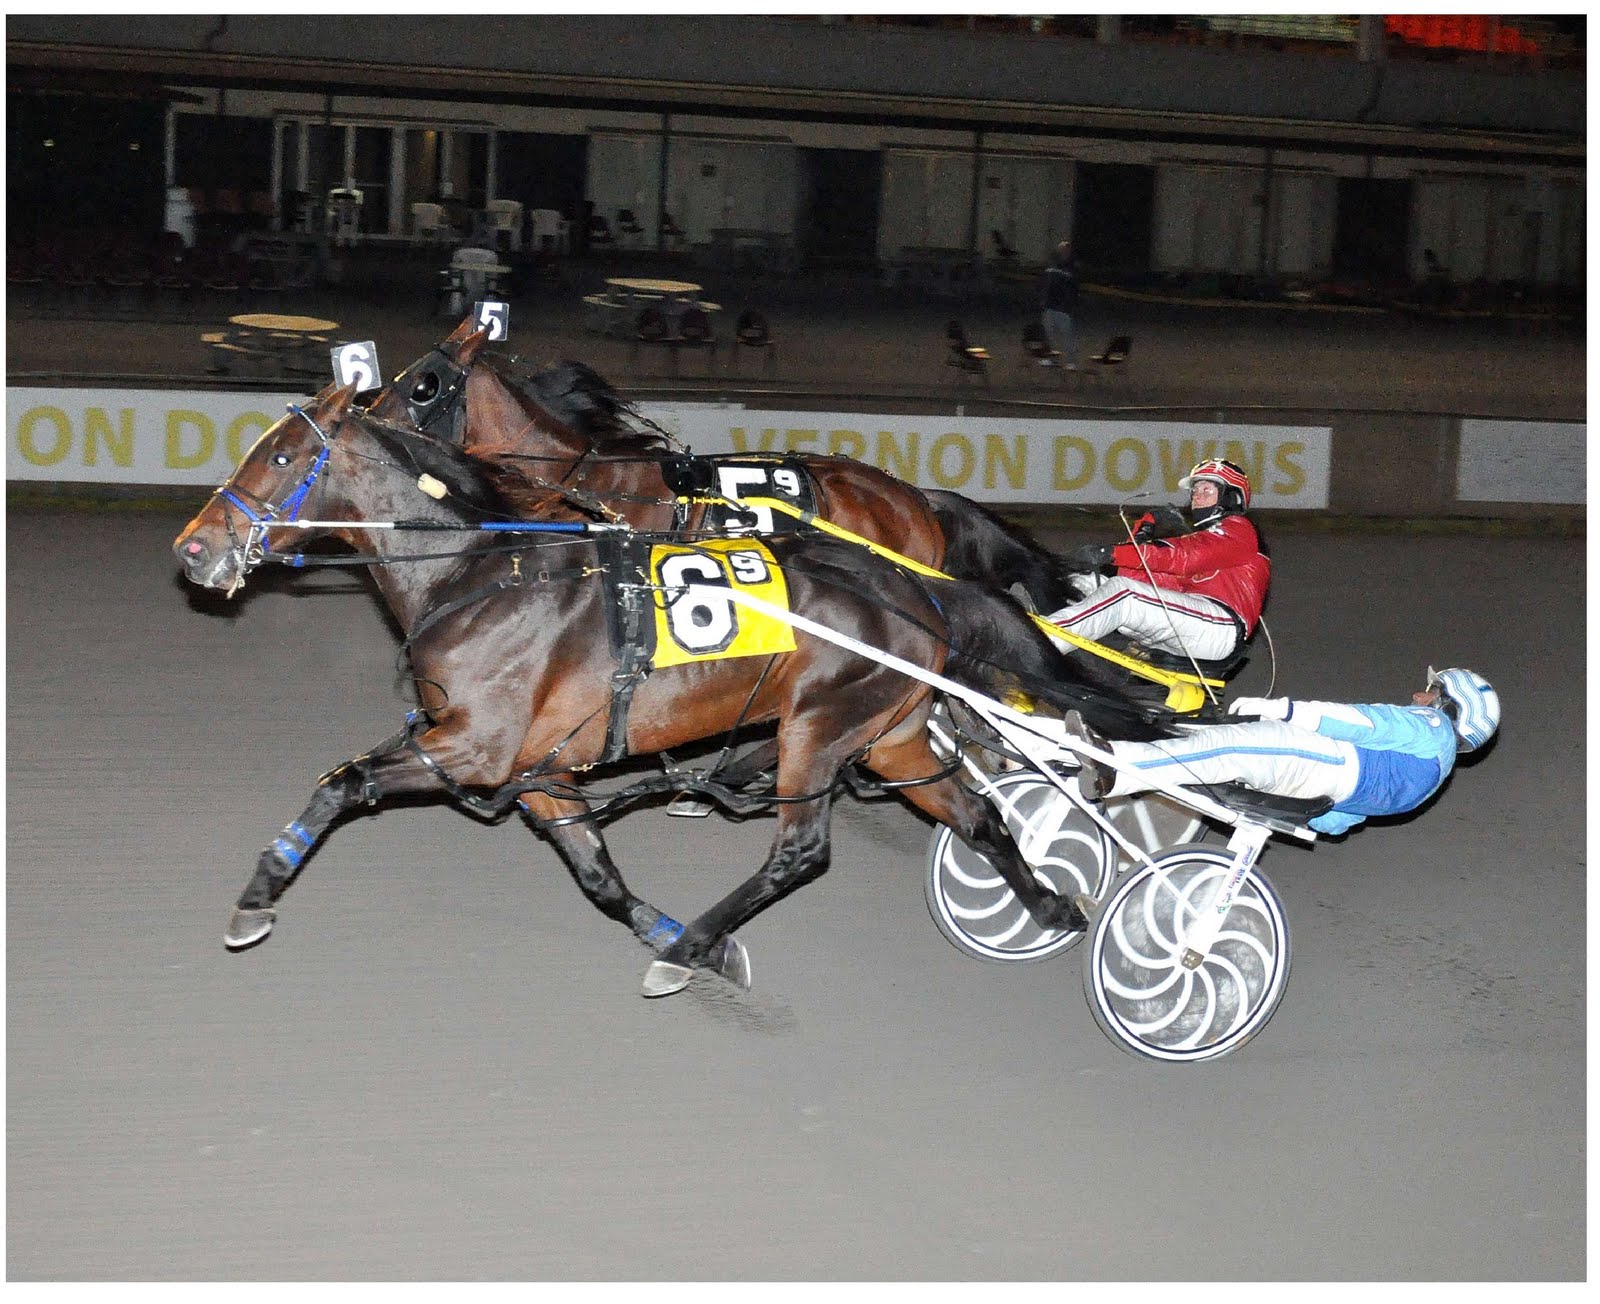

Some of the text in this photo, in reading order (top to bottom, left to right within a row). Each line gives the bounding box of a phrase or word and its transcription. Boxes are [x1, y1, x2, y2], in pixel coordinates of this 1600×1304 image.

[478, 302, 504, 341] 5
[338, 345, 376, 393] 6
[16, 405, 135, 469] ON
[717, 466, 801, 537] 5 9
[659, 551, 768, 649] 6 9
